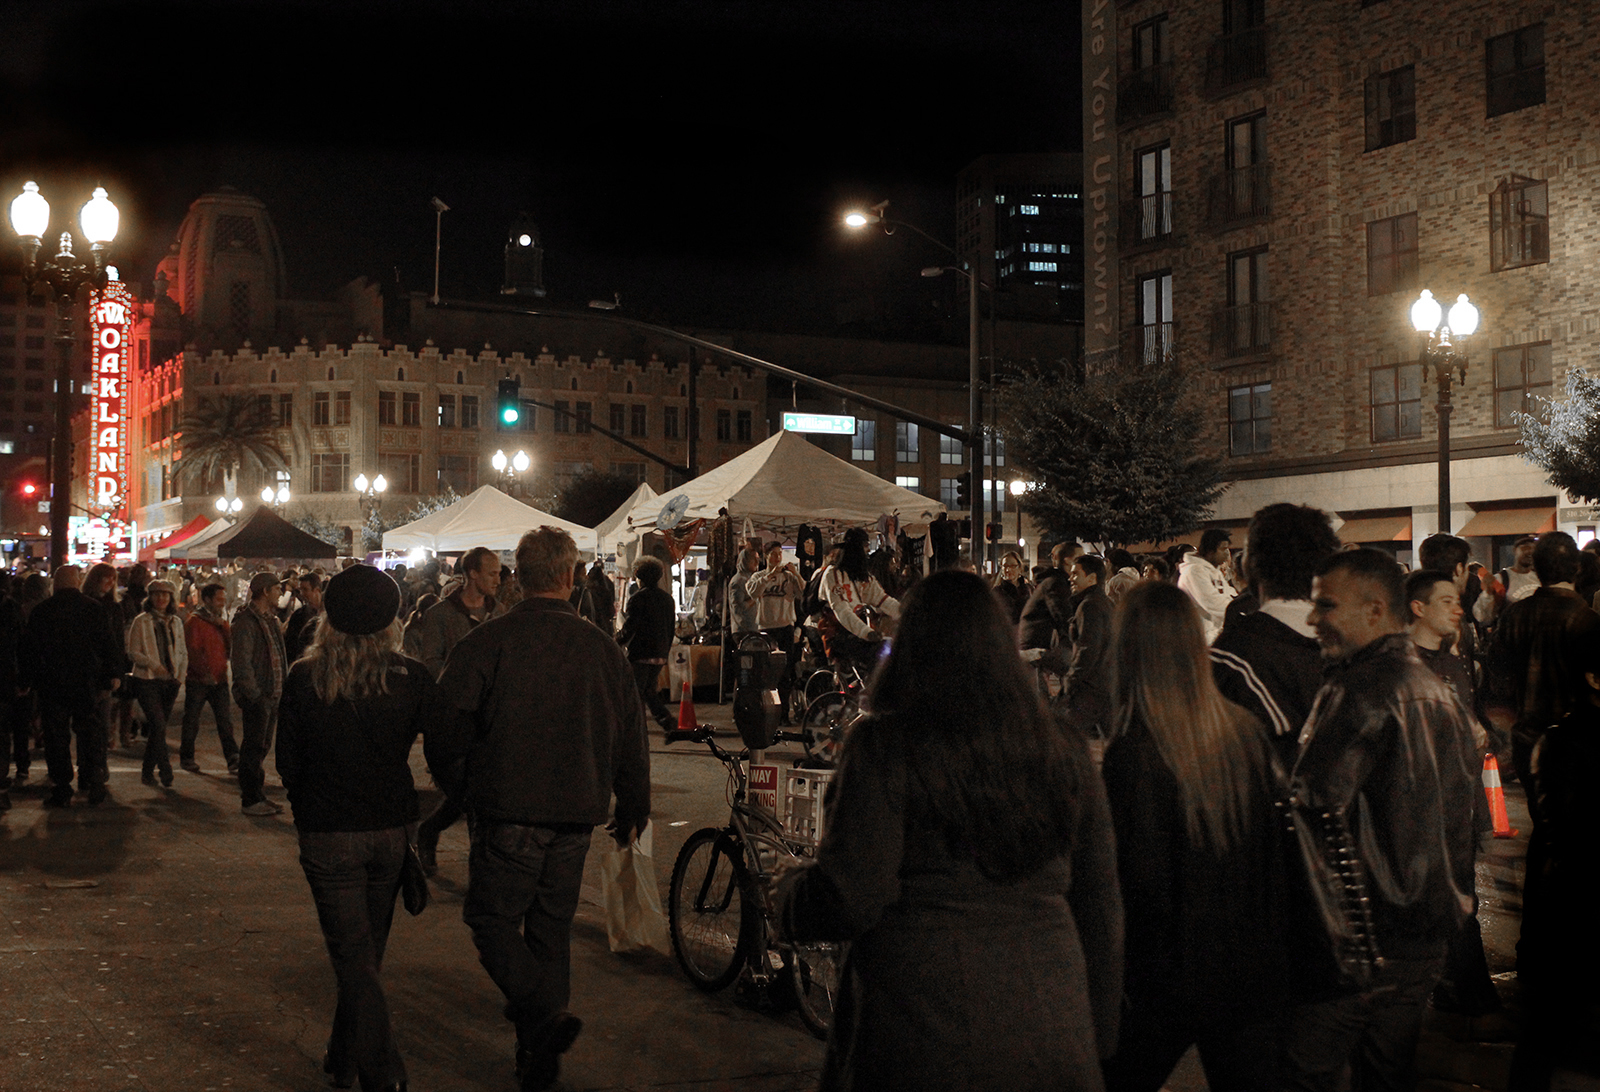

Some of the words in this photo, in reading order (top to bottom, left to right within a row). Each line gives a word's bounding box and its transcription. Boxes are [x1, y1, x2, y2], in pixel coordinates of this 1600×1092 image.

[1091, 66, 1110, 142] You
[1089, 154, 1113, 335] Uptown?
[97, 301, 126, 324] FOX
[98, 328, 121, 499] OAKLAND
[796, 417, 832, 430] William
